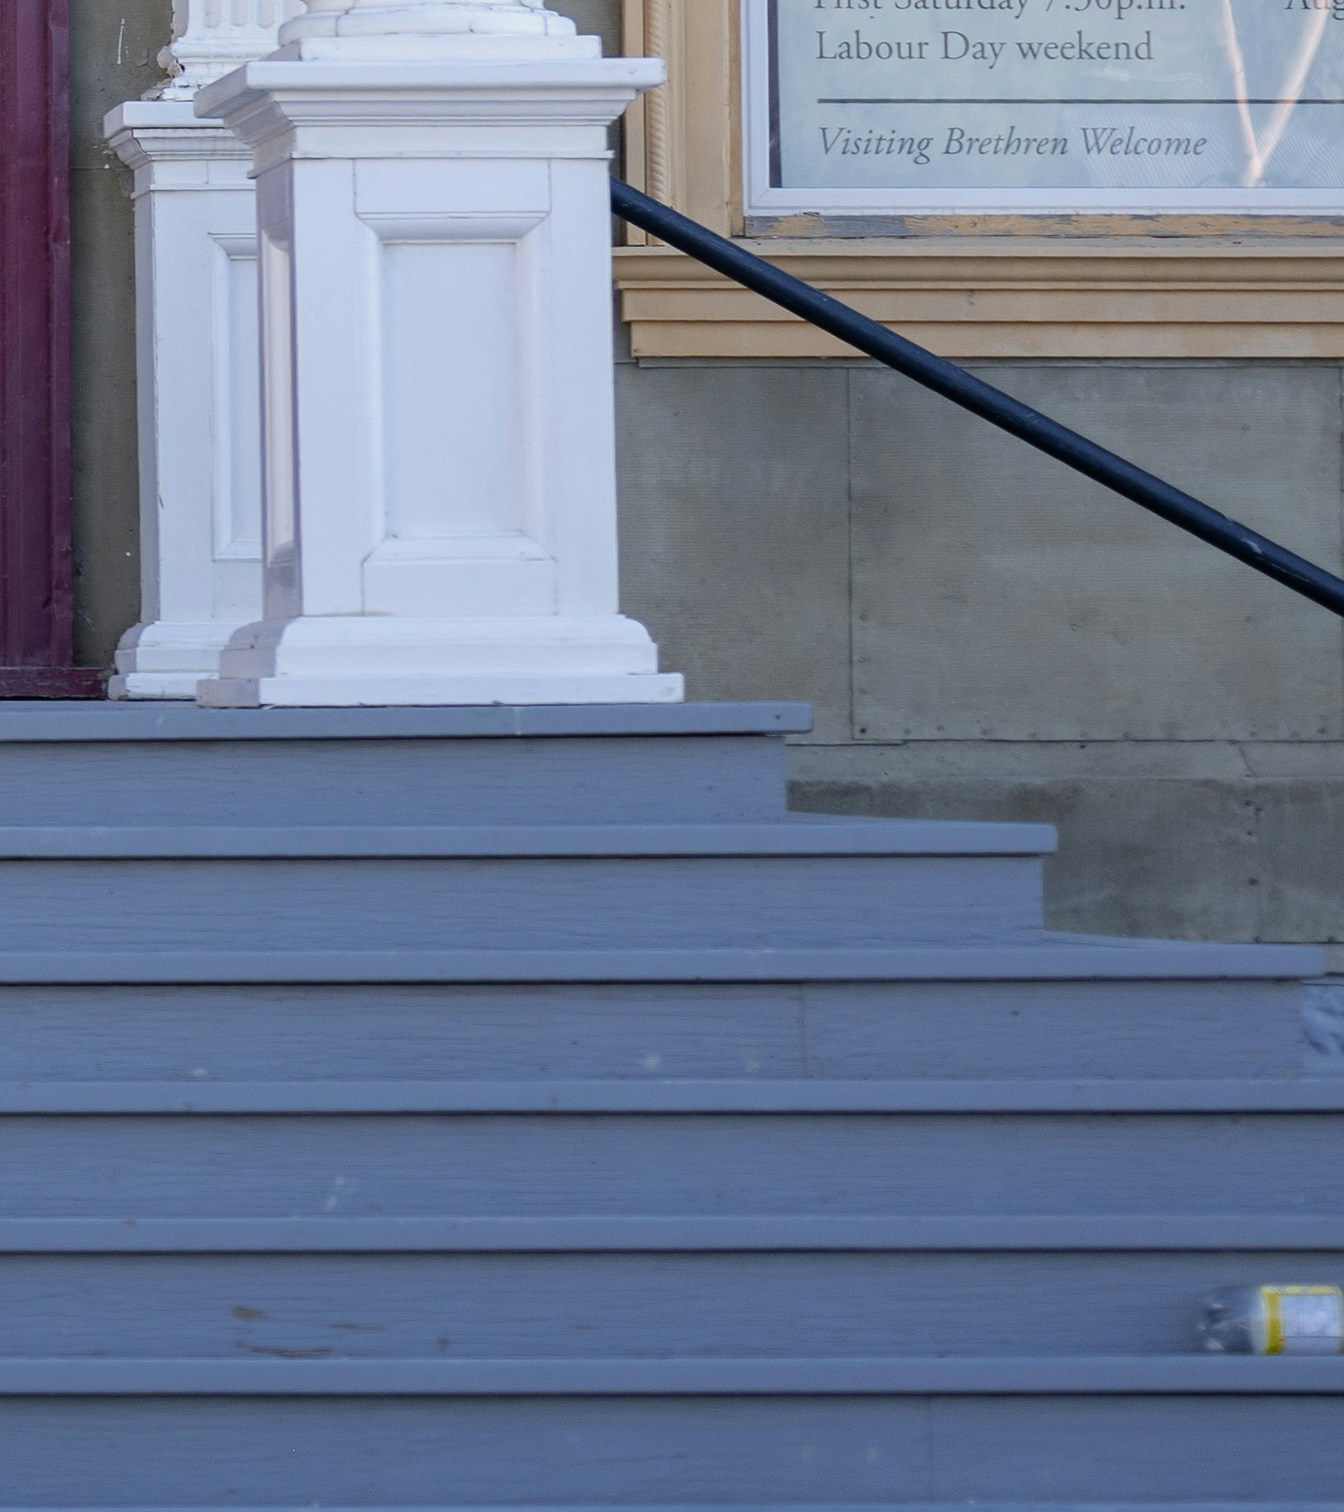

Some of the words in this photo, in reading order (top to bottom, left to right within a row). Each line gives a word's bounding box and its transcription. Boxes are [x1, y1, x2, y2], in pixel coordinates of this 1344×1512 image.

[816, 30, 930, 62] Labour
[941, 31, 1007, 71] Day
[1017, 30, 1154, 62] weekend
[819, 126, 934, 166] Visiting
[942, 126, 1070, 157] Brethren
[1081, 126, 1208, 157] Welcome
